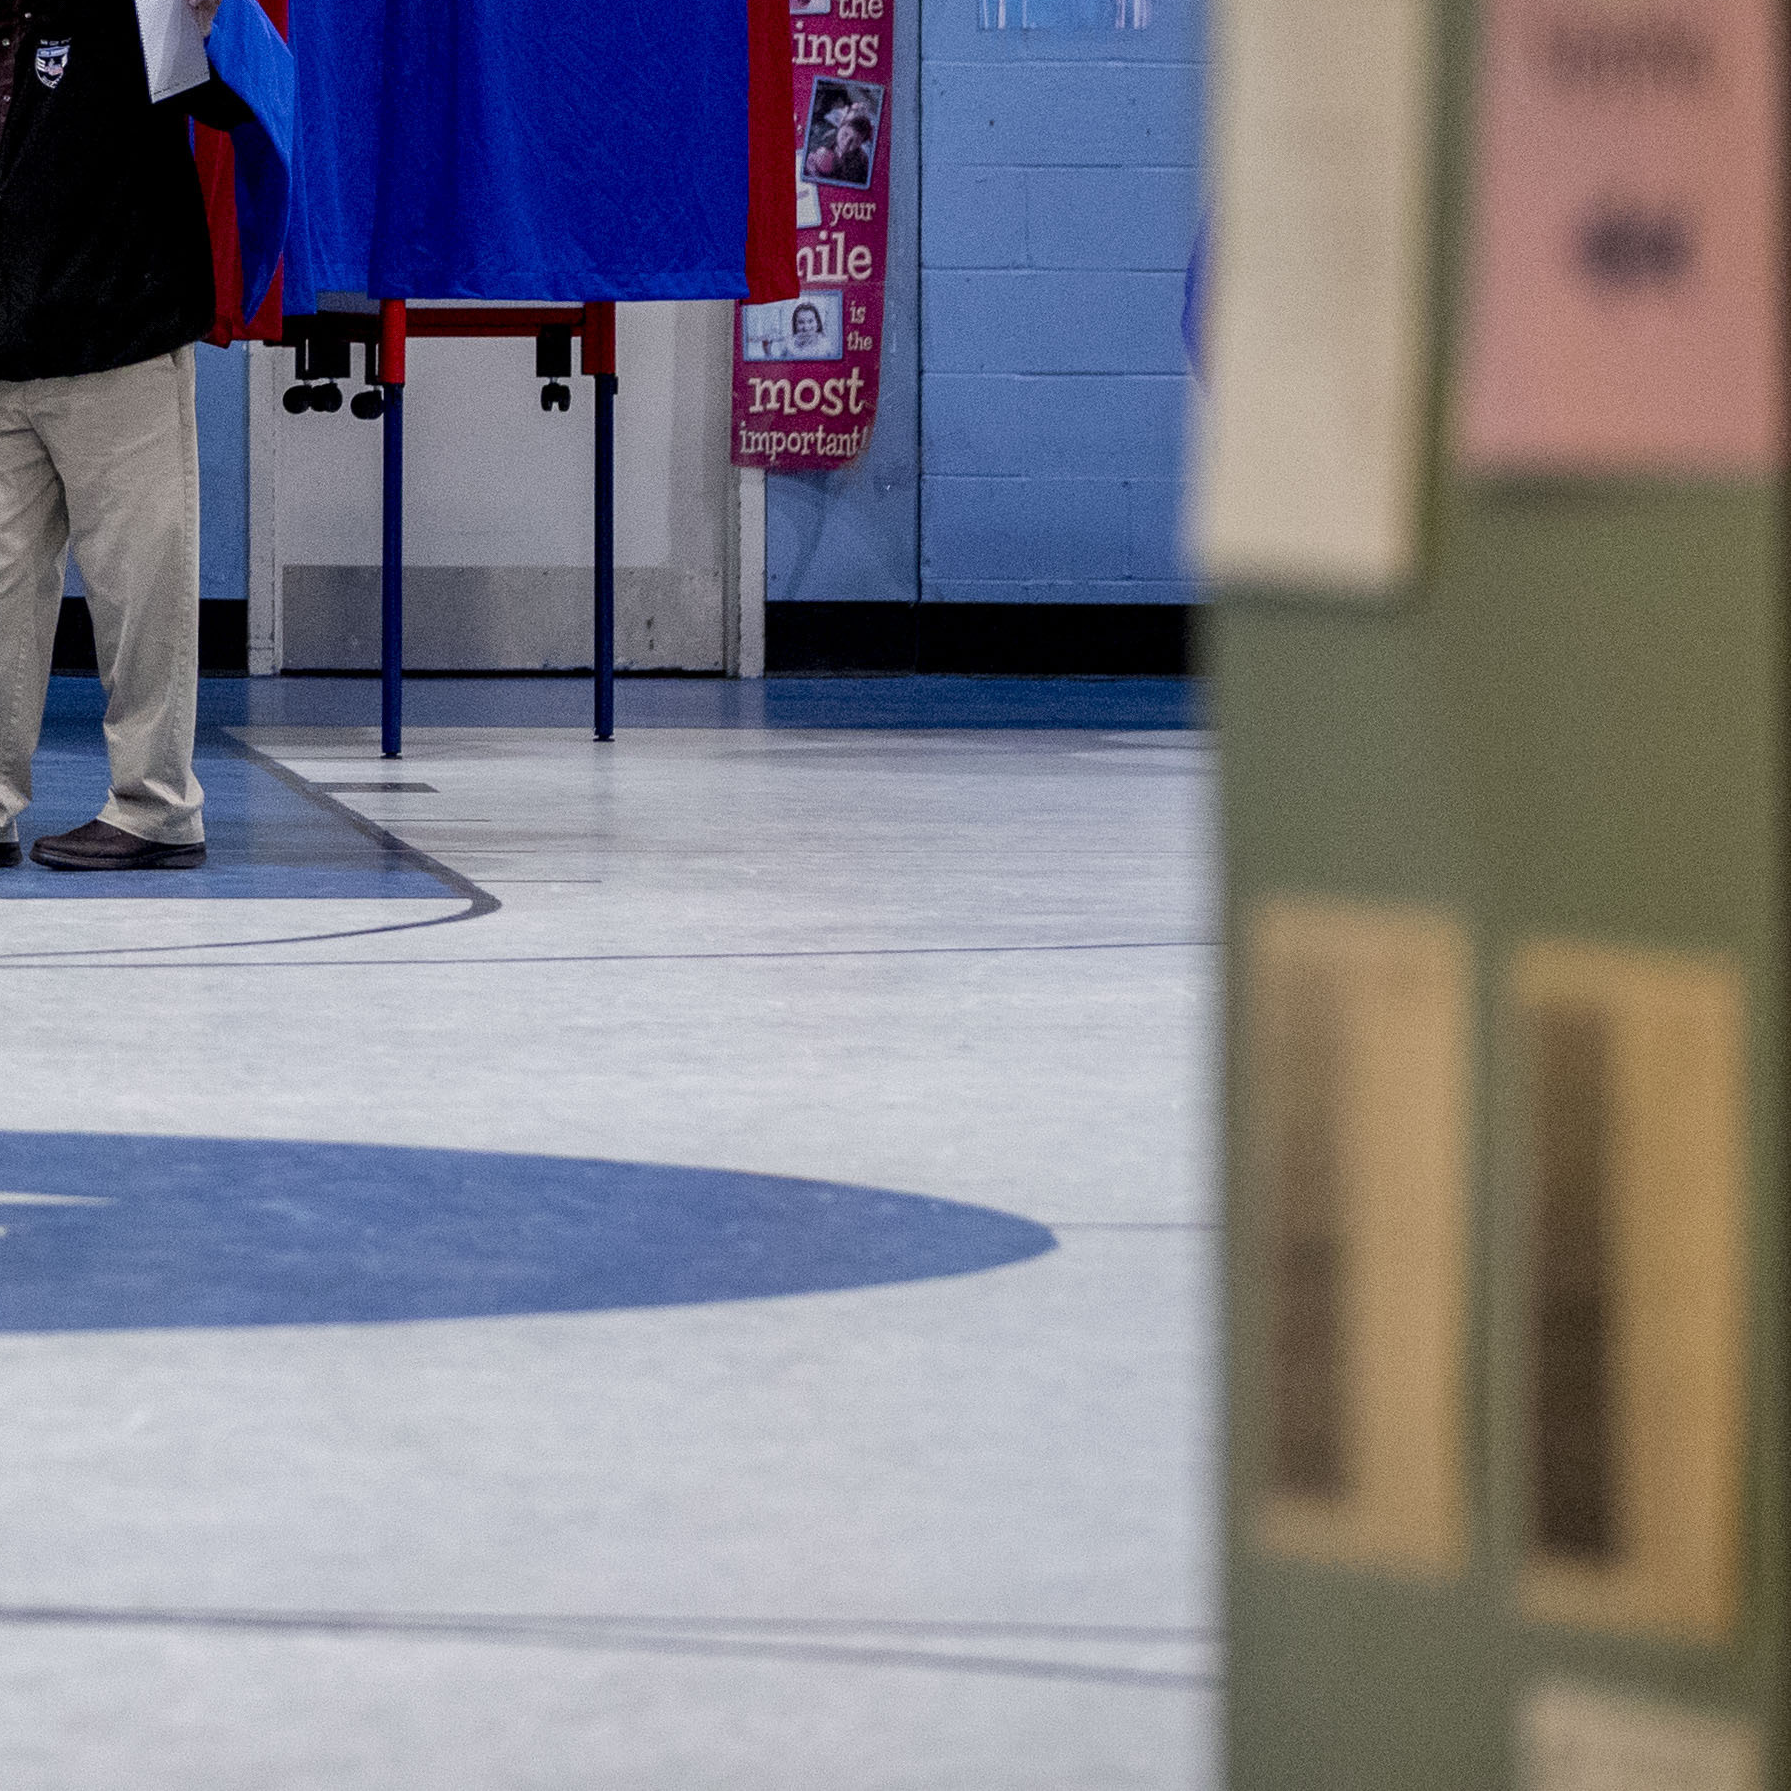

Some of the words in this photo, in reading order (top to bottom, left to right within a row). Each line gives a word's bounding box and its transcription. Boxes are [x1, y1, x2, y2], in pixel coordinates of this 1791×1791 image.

[792, 19, 880, 78] ings
[829, 202, 876, 227] your
[850, 301, 866, 325] is
[847, 330, 873, 352] the
[748, 366, 865, 416] most
[739, 420, 868, 460] important!
